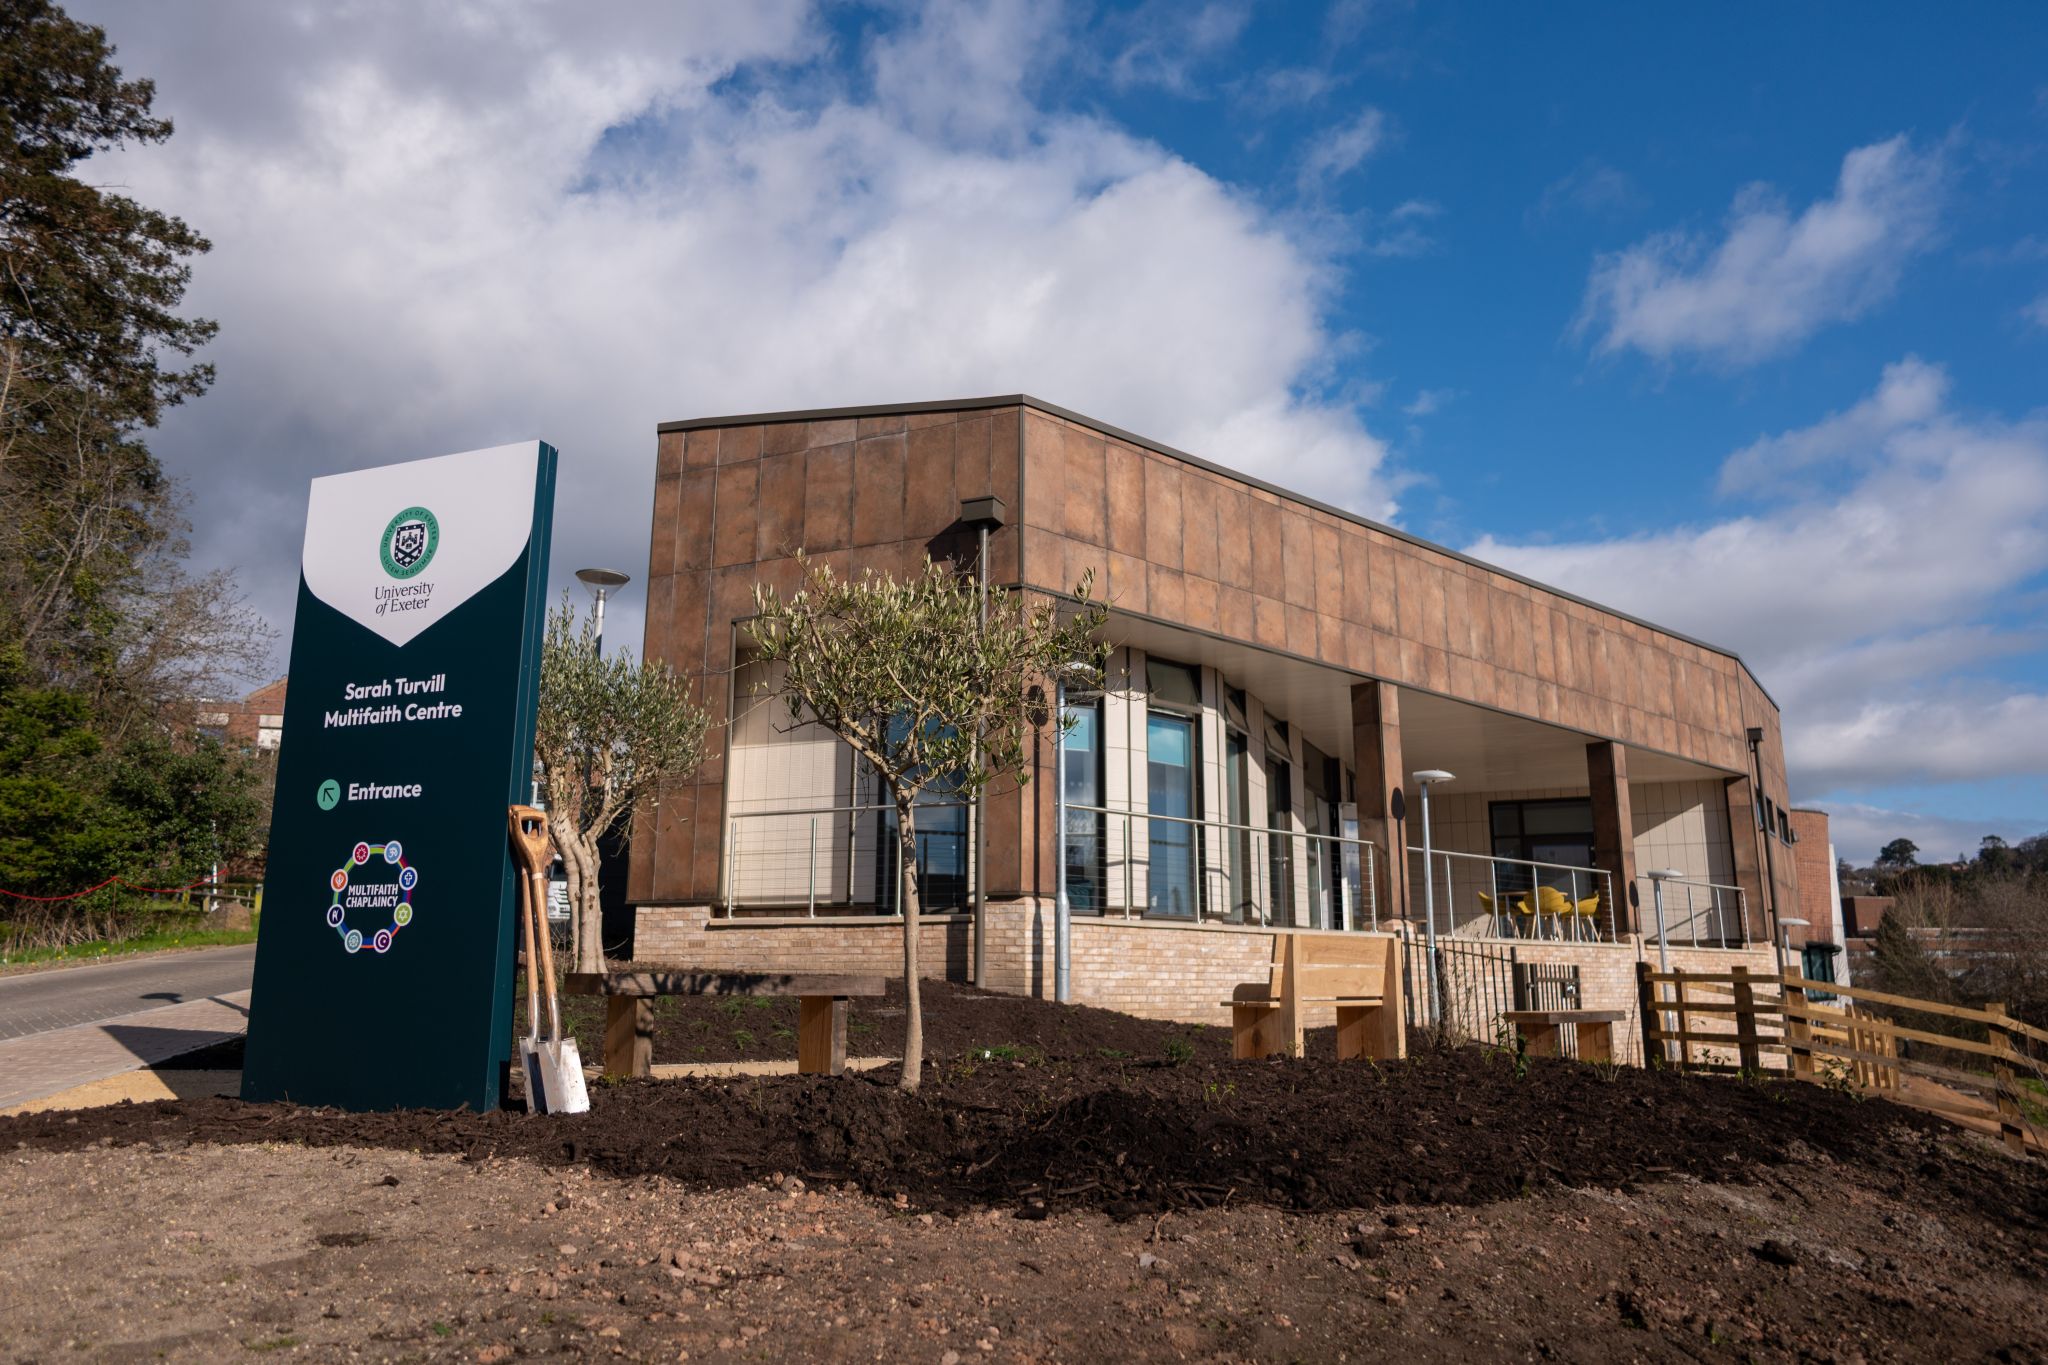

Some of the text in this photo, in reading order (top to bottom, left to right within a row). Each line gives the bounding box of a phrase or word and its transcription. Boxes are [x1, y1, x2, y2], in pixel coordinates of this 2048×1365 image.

[374, 581, 434, 600] University
[375, 597, 430, 616] of Exeter
[344, 674, 446, 700] Sarah Turvill
[324, 701, 463, 728] Multifaith Centre
[348, 782, 422, 801] Entrance
[348, 884, 398, 895] MULTIFAITH
[346, 896, 398, 908] CHAPLAINCY
